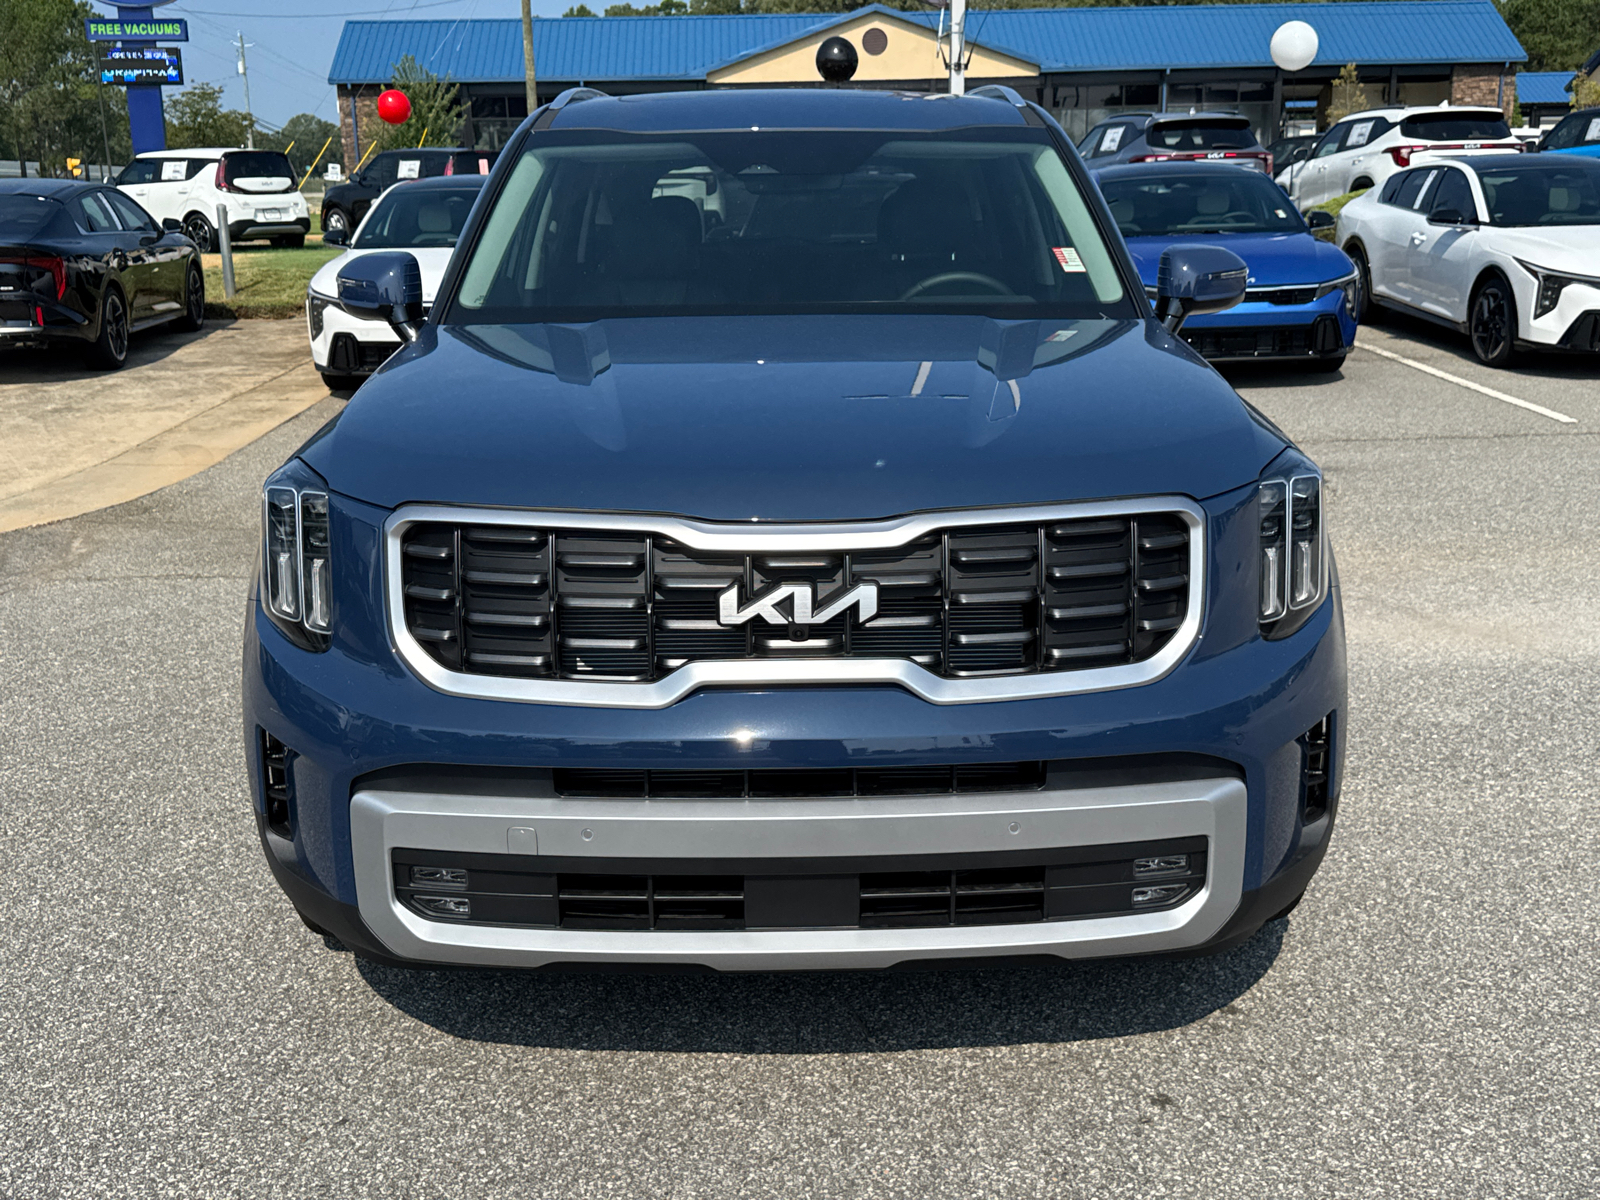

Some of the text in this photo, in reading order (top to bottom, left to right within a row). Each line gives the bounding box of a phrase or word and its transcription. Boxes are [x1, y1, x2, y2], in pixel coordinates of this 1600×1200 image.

[90, 23, 181, 35] FREE VACUUMS
[719, 582, 878, 625] KIA
